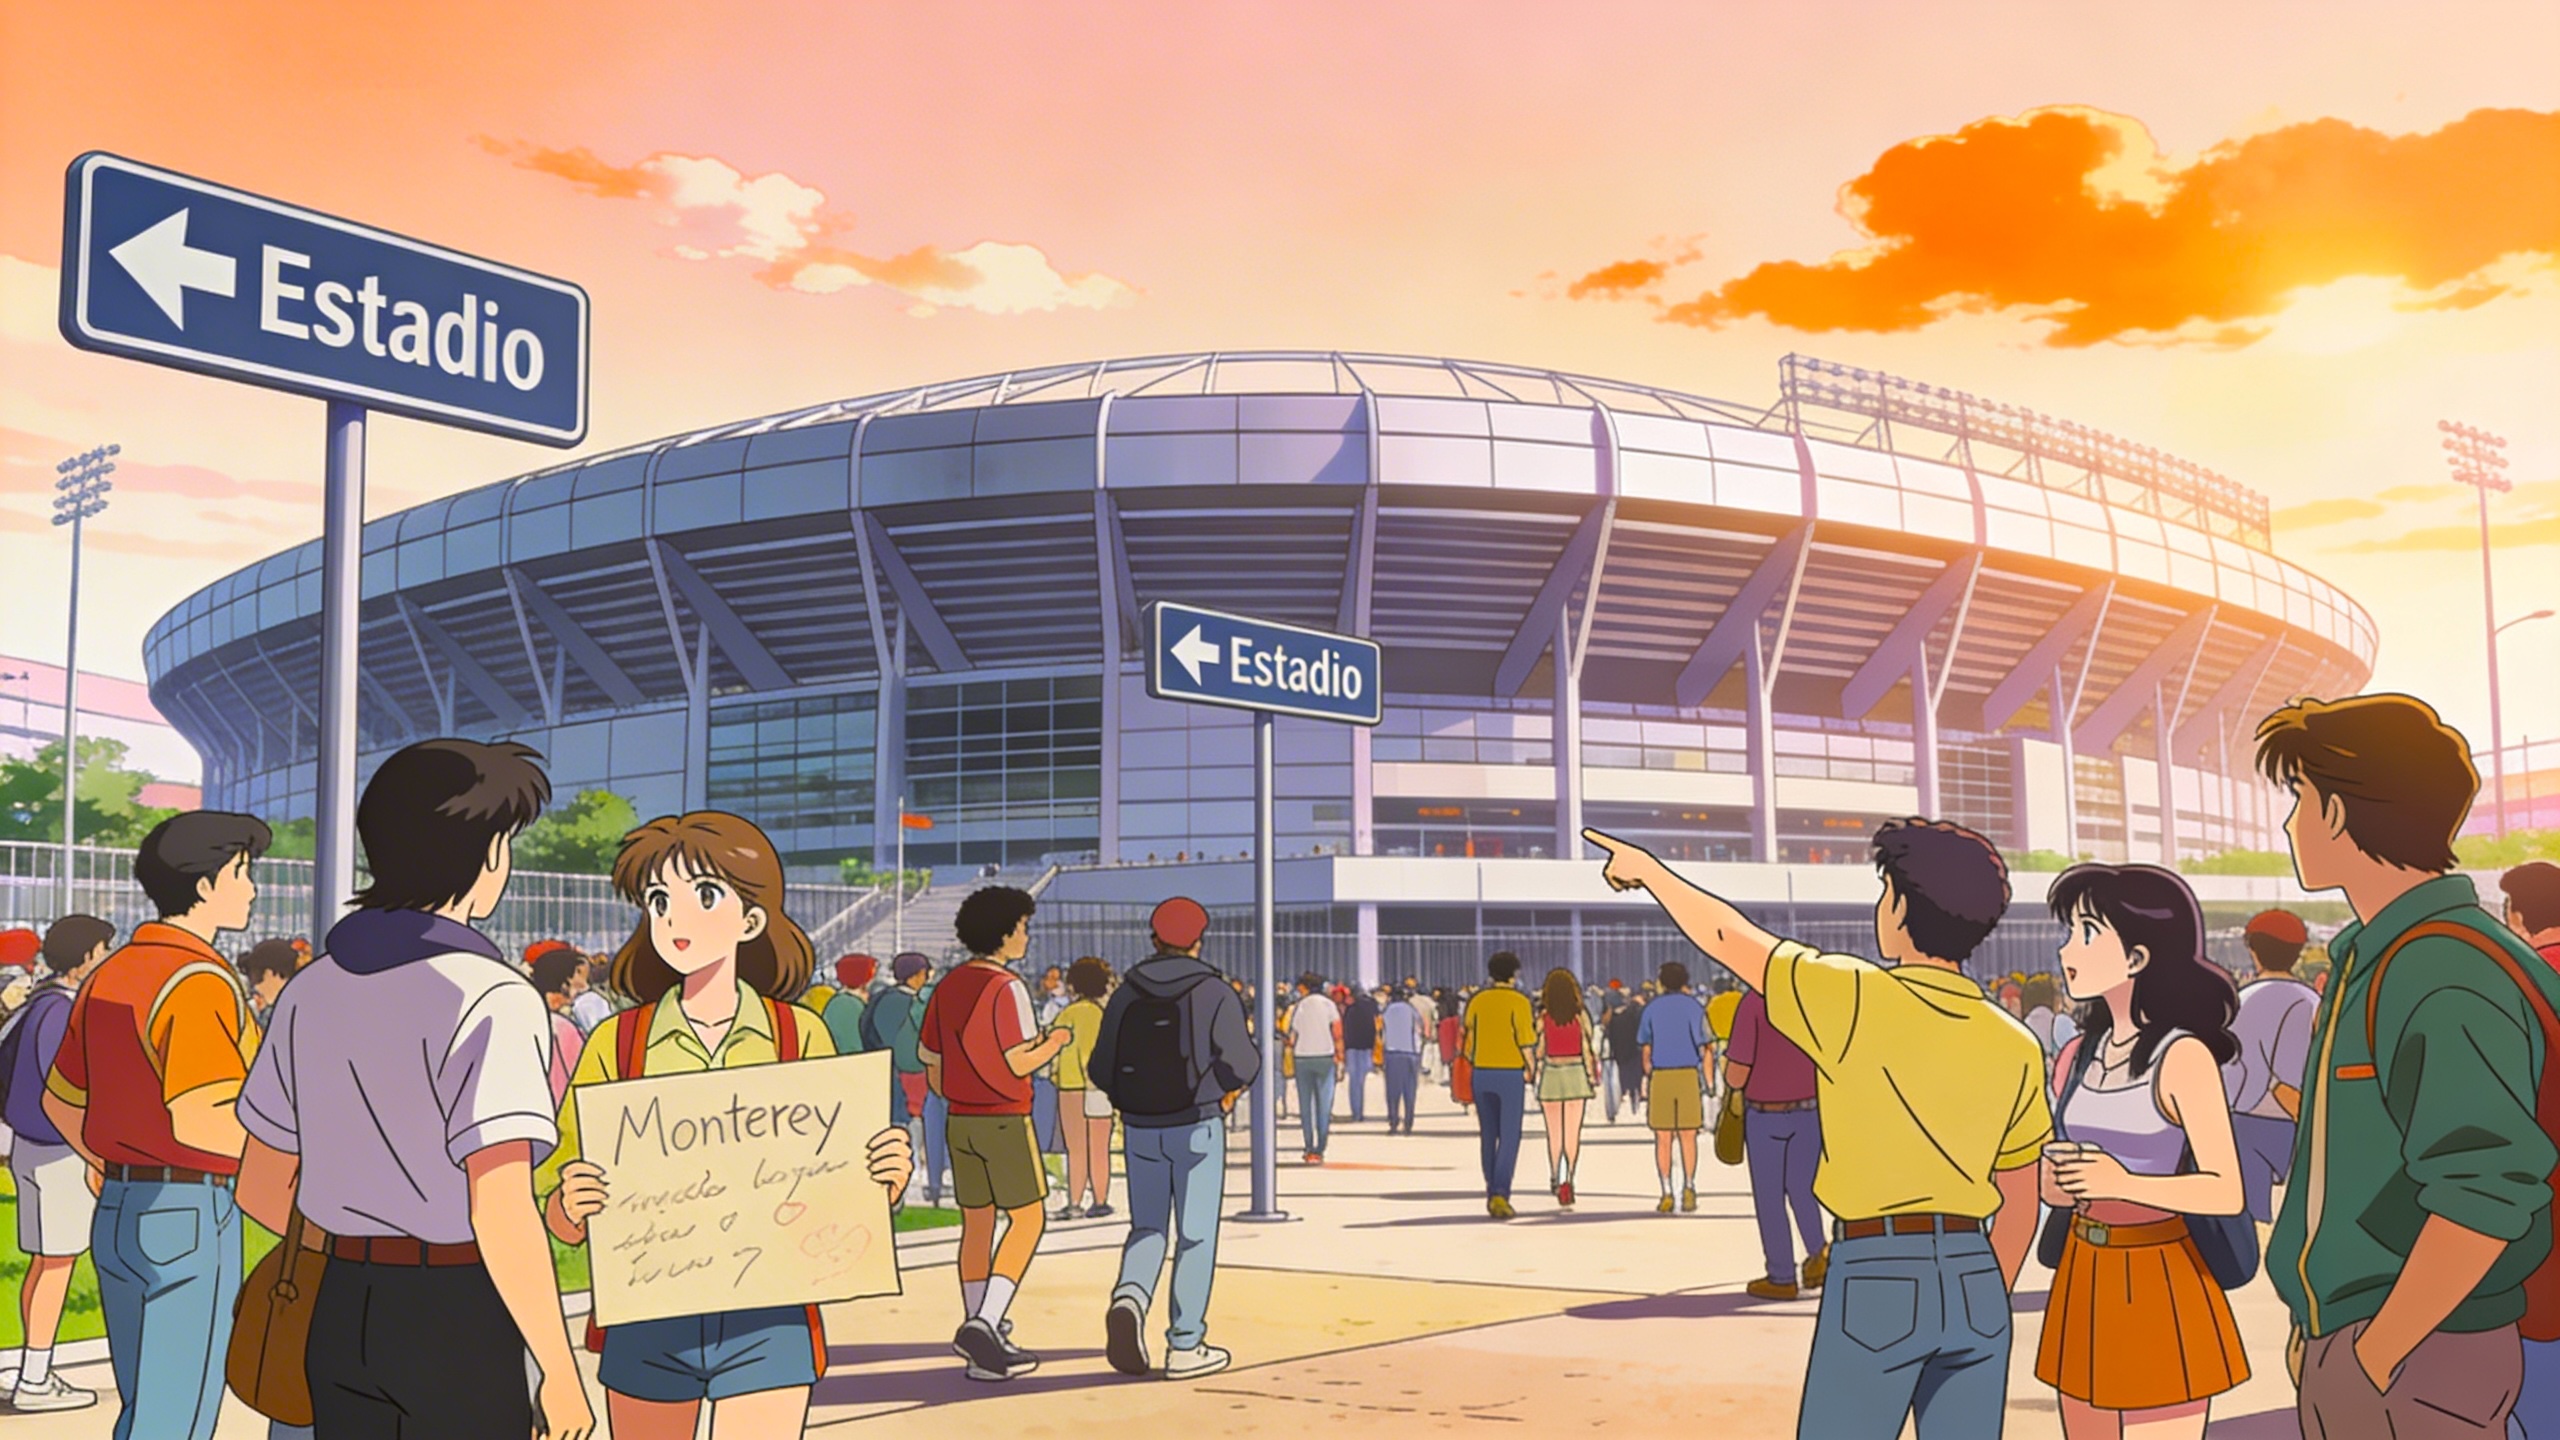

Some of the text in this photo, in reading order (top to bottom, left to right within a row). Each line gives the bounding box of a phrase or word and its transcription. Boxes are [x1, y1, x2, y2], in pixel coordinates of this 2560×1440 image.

[260, 244, 545, 391] Estadio
[1230, 636, 1363, 700] Estadio
[614, 1094, 842, 1166] Monterey
